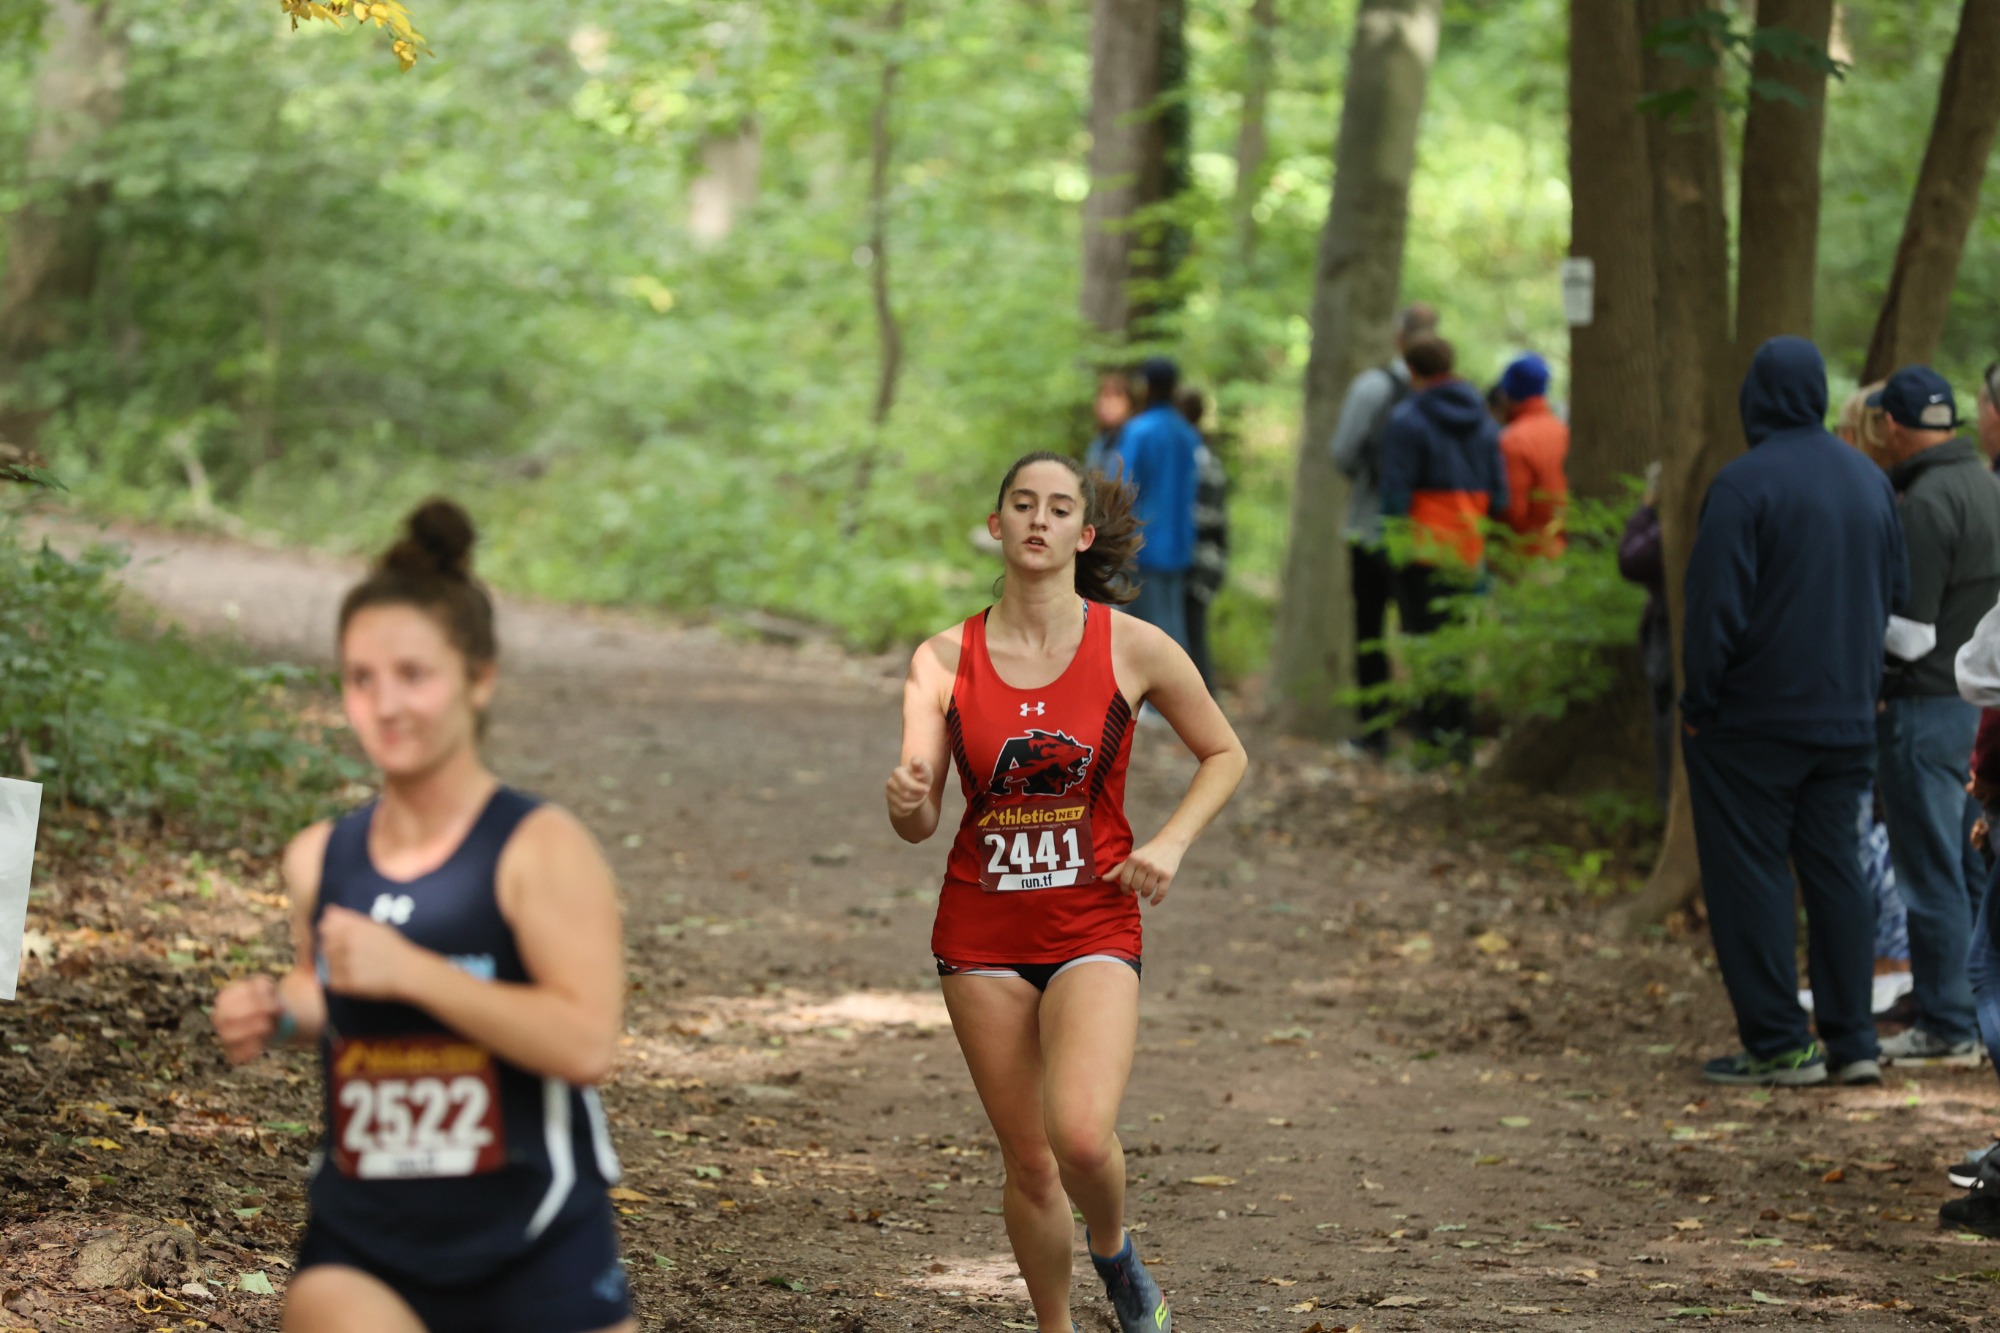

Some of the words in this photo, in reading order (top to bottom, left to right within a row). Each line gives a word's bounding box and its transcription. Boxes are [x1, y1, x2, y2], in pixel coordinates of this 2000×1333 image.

[984, 828, 1085, 873] 2441
[1021, 874, 1053, 888] run.tf
[339, 1076, 494, 1151] 2522
